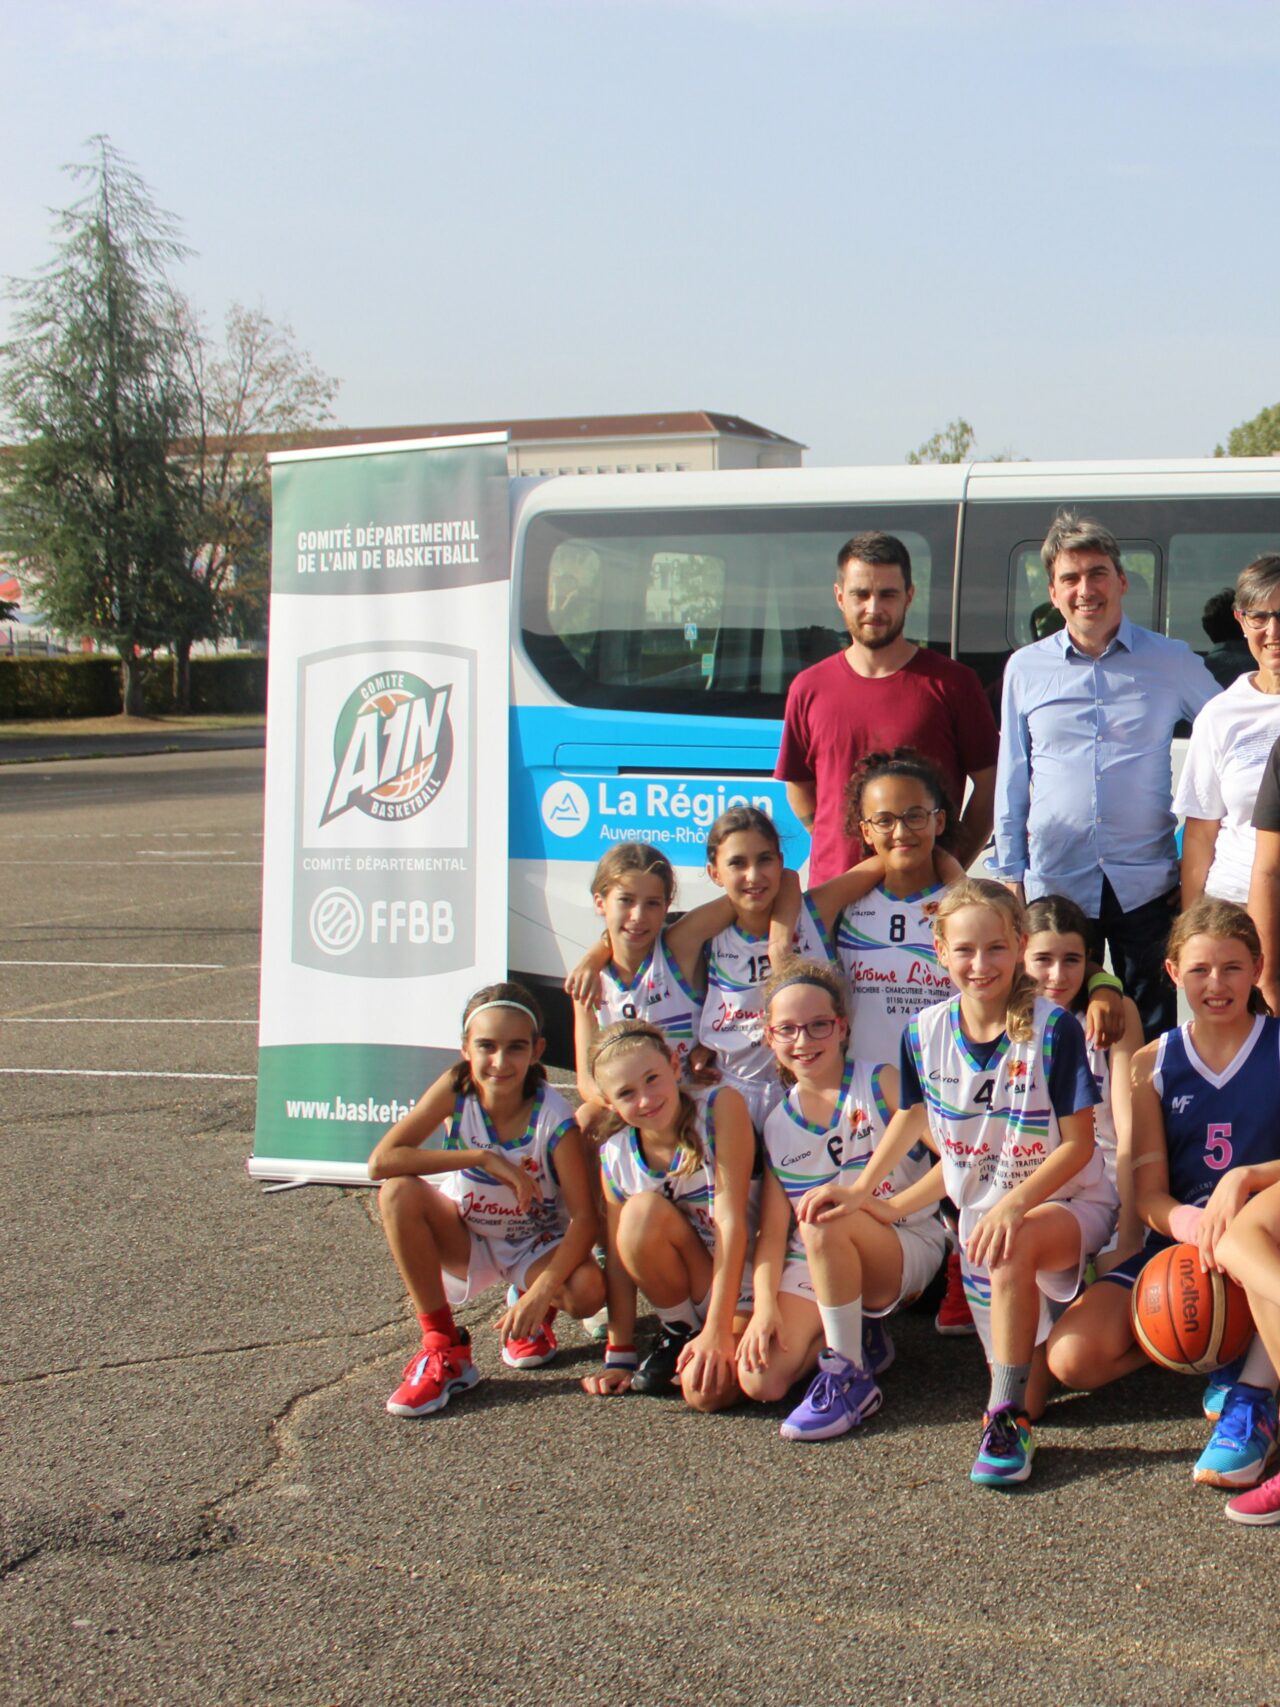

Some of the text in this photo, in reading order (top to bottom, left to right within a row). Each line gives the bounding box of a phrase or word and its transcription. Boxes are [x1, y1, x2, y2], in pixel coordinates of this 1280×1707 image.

[297, 520, 479, 551] COMITÉ DÉPARTEMENTAL
[297, 543, 479, 573] DE L'AIN DE BASKETBALL
[370, 777, 441, 818] BASKETBALL
[598, 783, 637, 816] La
[600, 824, 709, 844] Auvergne-Rhô
[303, 855, 468, 871] COMITÉ DÉPARTEMENTAL
[371, 899, 455, 945] FFBB
[889, 914, 906, 942] 8
[748, 954, 771, 983] 12
[973, 1079, 996, 1111] 4
[1203, 1122, 1233, 1170] 5
[1179, 1258, 1200, 1333] molten
